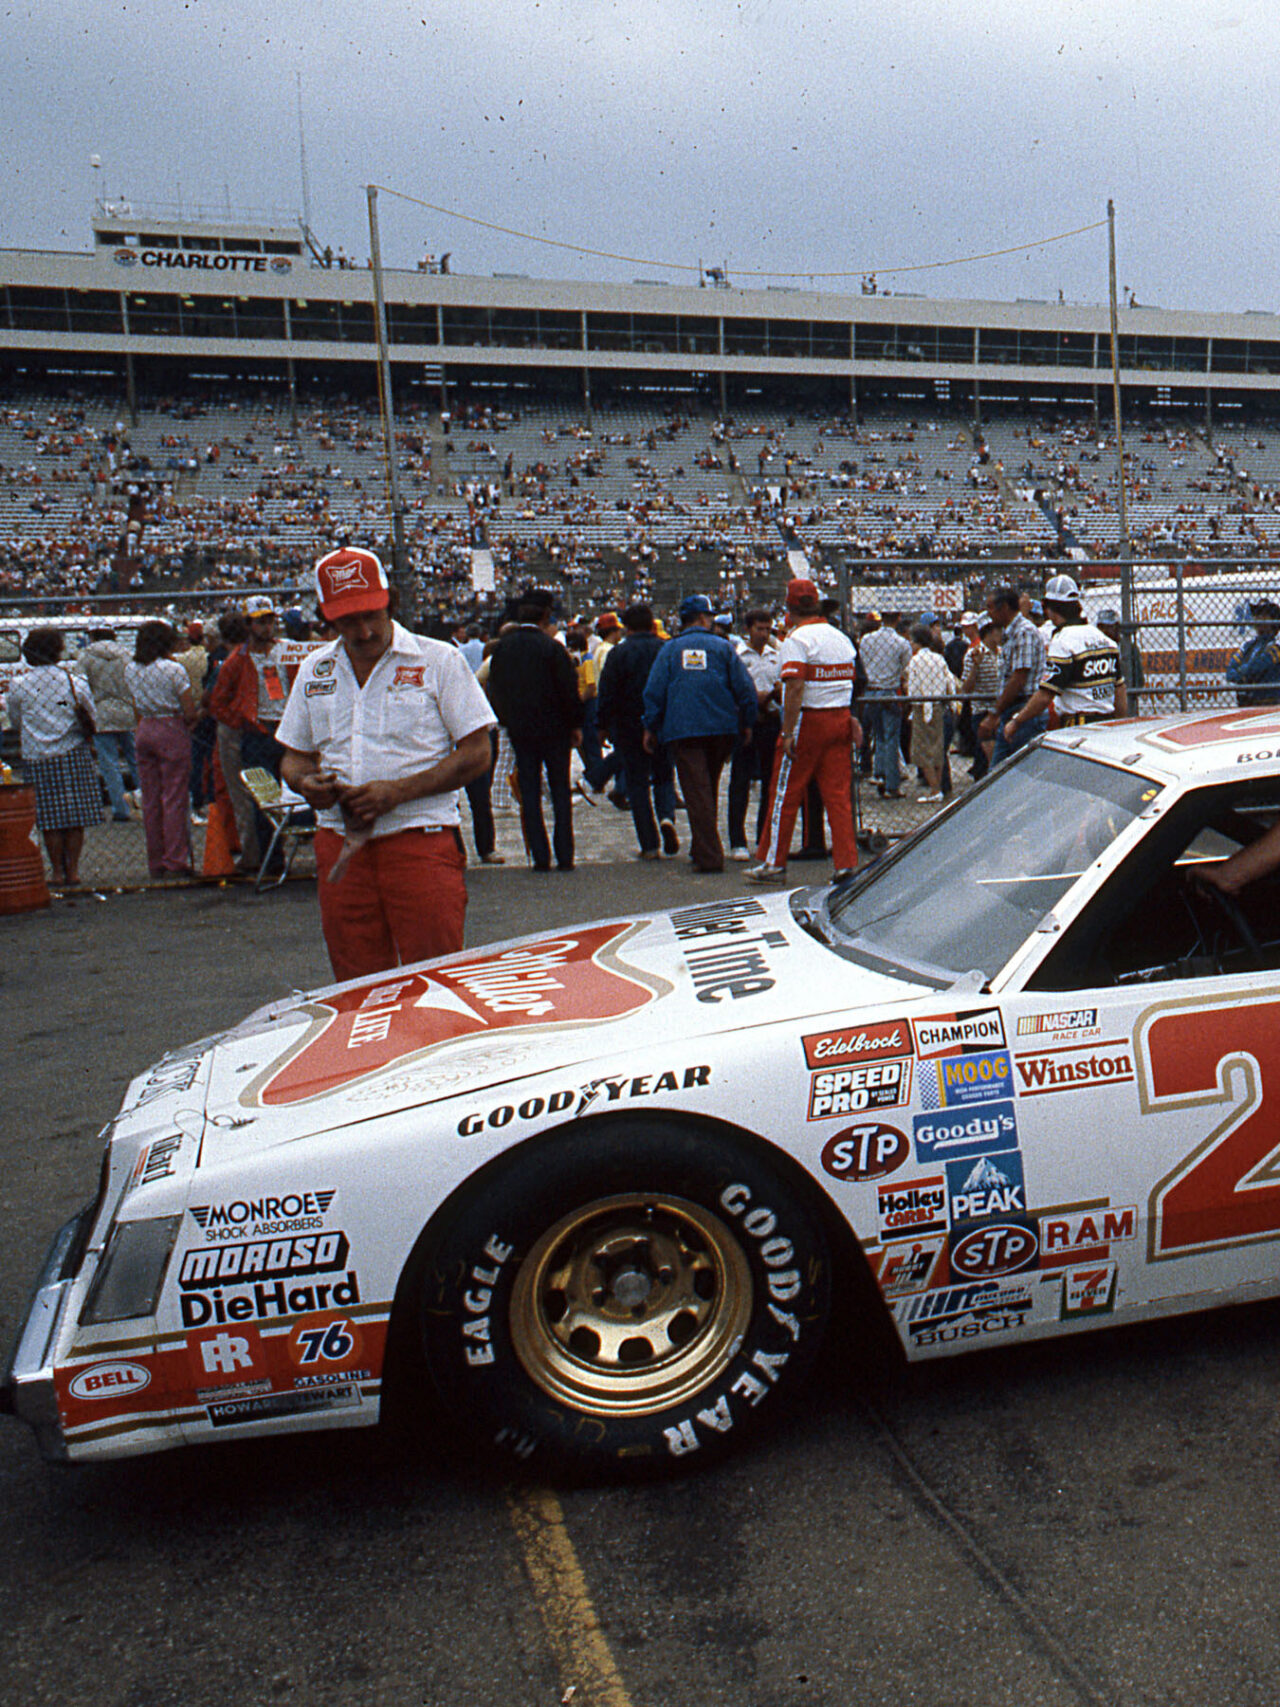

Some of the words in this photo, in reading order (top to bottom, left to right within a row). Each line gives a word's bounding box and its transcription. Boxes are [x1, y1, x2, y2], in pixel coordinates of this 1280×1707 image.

[141, 251, 267, 272] CHARLOTTE
[437, 940, 579, 1016] Miller
[683, 930, 790, 1003] Time
[348, 1004, 402, 1048] LIFE
[919, 1020, 999, 1044] CHAMPION
[1043, 1010, 1093, 1031] NASCAR
[814, 1029, 903, 1058] Edelbrock
[815, 1063, 900, 1096] SPEED
[945, 1057, 1009, 1086] MOOG
[1015, 1055, 1134, 1087] Winston
[813, 1088, 869, 1116] PRO
[915, 1113, 1015, 1150] Goody's
[831, 1125, 899, 1172] STP
[208, 1193, 318, 1227] MONROE
[878, 1188, 945, 1214] Holley
[885, 1207, 935, 1227] CARBS
[952, 1184, 1024, 1220] PEAK
[206, 1225, 248, 1242] SHOCK
[253, 1216, 323, 1237] ABSORBERS
[1047, 1210, 1134, 1249] RAM
[179, 1231, 348, 1288] MOROSO
[963, 1230, 1025, 1267] STP
[180, 1270, 361, 1328] DieHard
[462, 1233, 514, 1367] EAGLE
[1073, 1267, 1109, 1310] 7
[296, 1320, 354, 1364] 76
[915, 1313, 1026, 1345] BUSCH
[84, 1370, 140, 1392] BELL
[293, 1369, 371, 1388] GASOLINE
